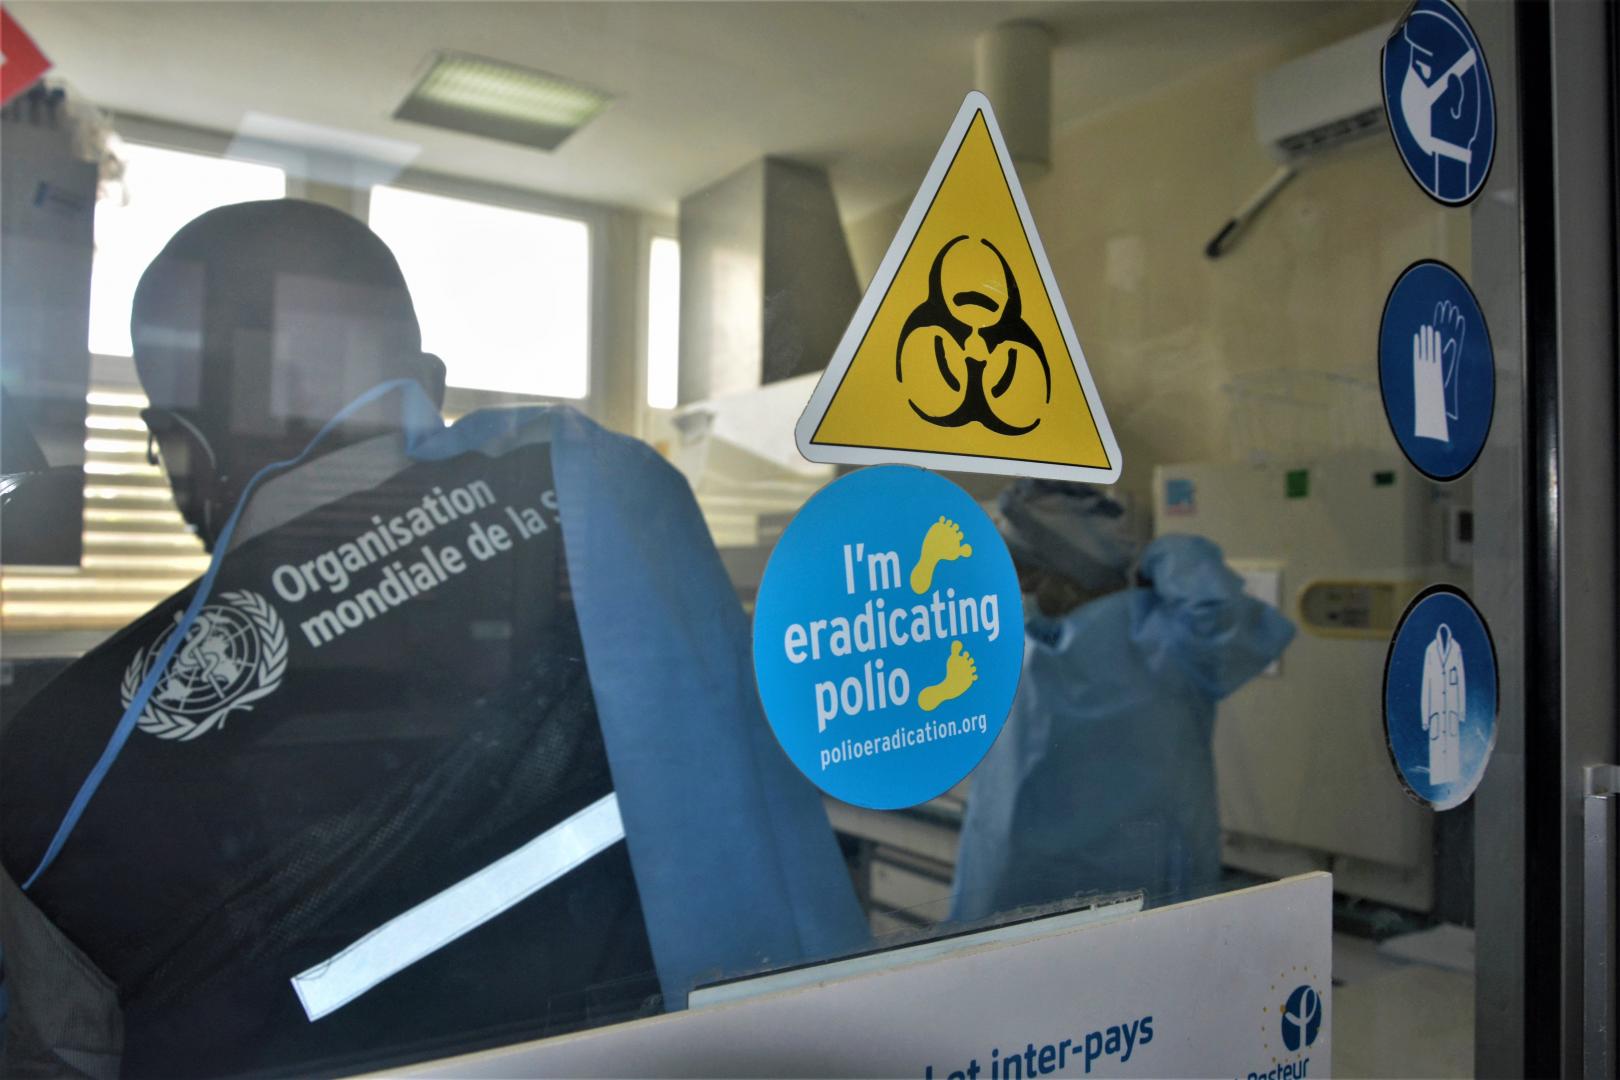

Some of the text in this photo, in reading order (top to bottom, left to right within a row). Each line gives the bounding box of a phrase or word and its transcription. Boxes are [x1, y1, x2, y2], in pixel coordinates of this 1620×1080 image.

[272, 480, 496, 602] Organisation
[300, 545, 467, 648] mondiale
[467, 521, 513, 561] de
[504, 505, 548, 540] la
[843, 543, 902, 595] I'm
[784, 587, 1000, 665] eradicating
[815, 658, 910, 733] polio
[820, 712, 988, 771] polioeradication.org
[991, 1015, 1154, 1080] inter-pays
